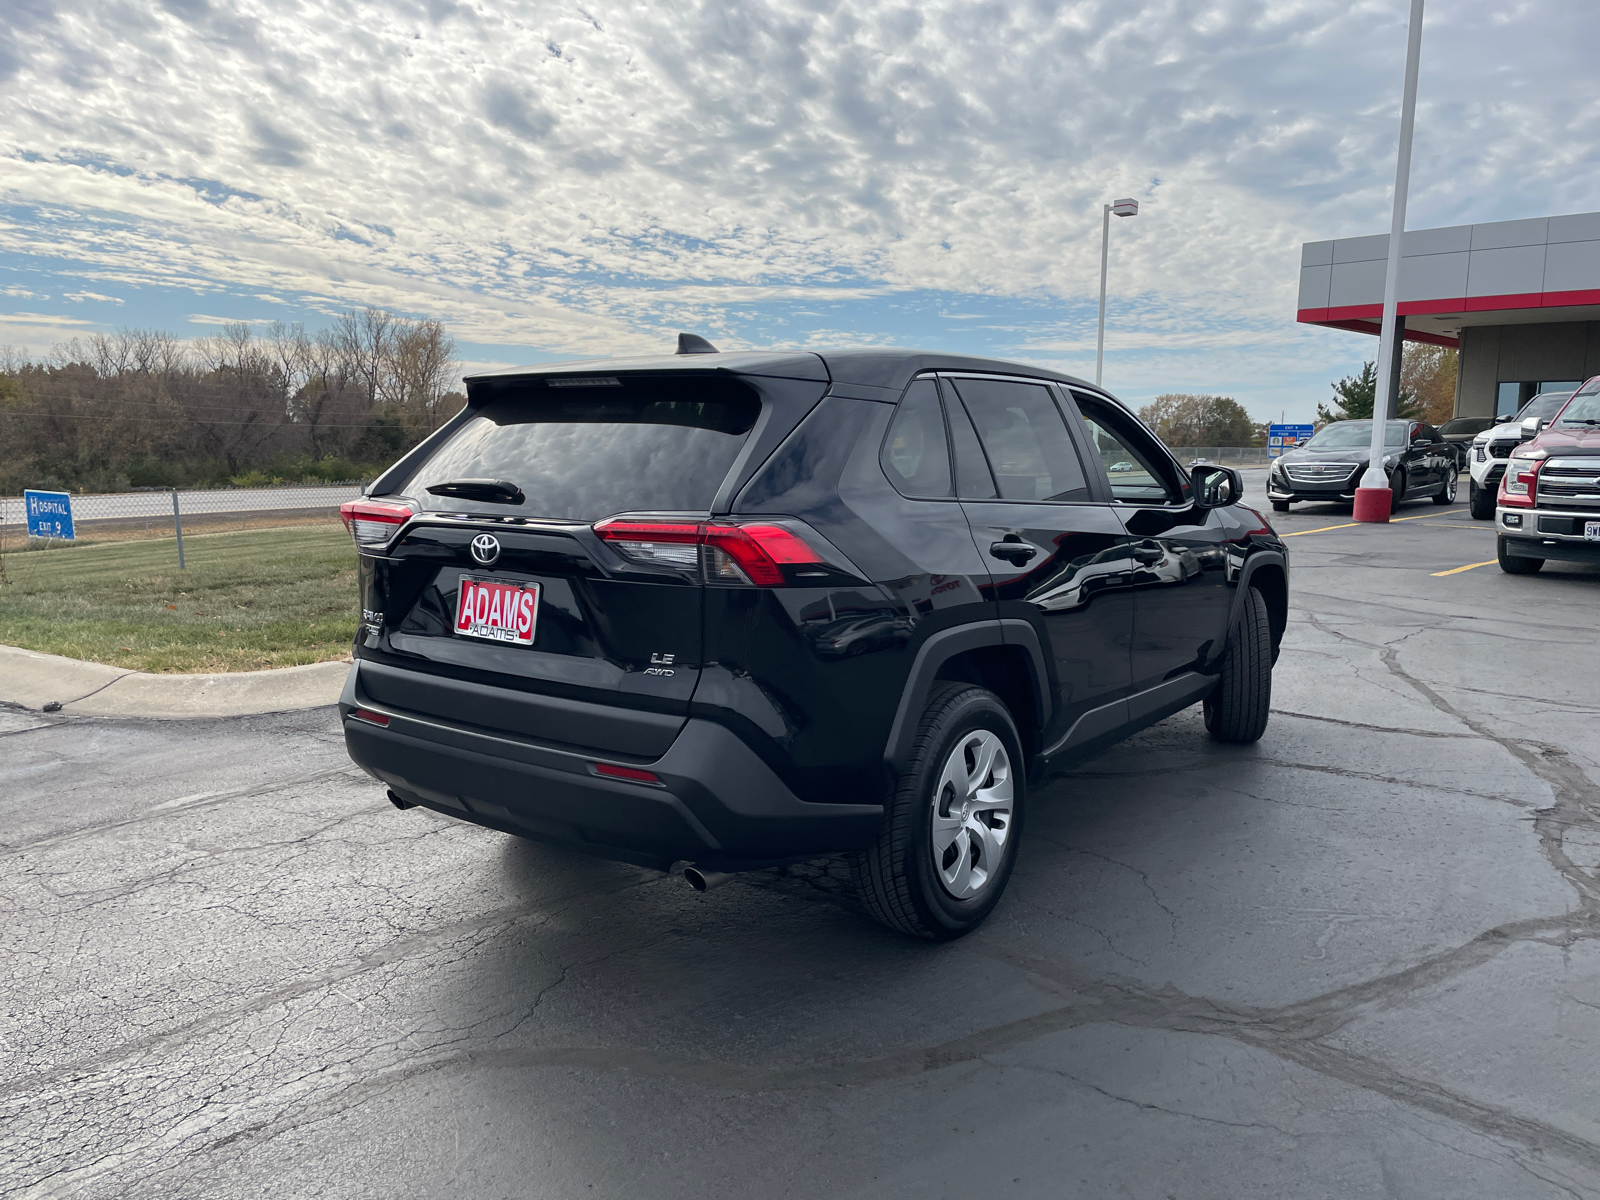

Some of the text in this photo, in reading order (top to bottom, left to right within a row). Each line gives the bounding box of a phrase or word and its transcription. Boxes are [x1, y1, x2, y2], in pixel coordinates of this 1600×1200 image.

[30, 497, 68, 515] HOSPITAL
[39, 521, 62, 534] EXIT 9
[460, 586, 533, 633] ADAMS
[471, 624, 516, 641] ADAMS
[650, 652, 675, 665] LE
[643, 667, 675, 677] AWD
